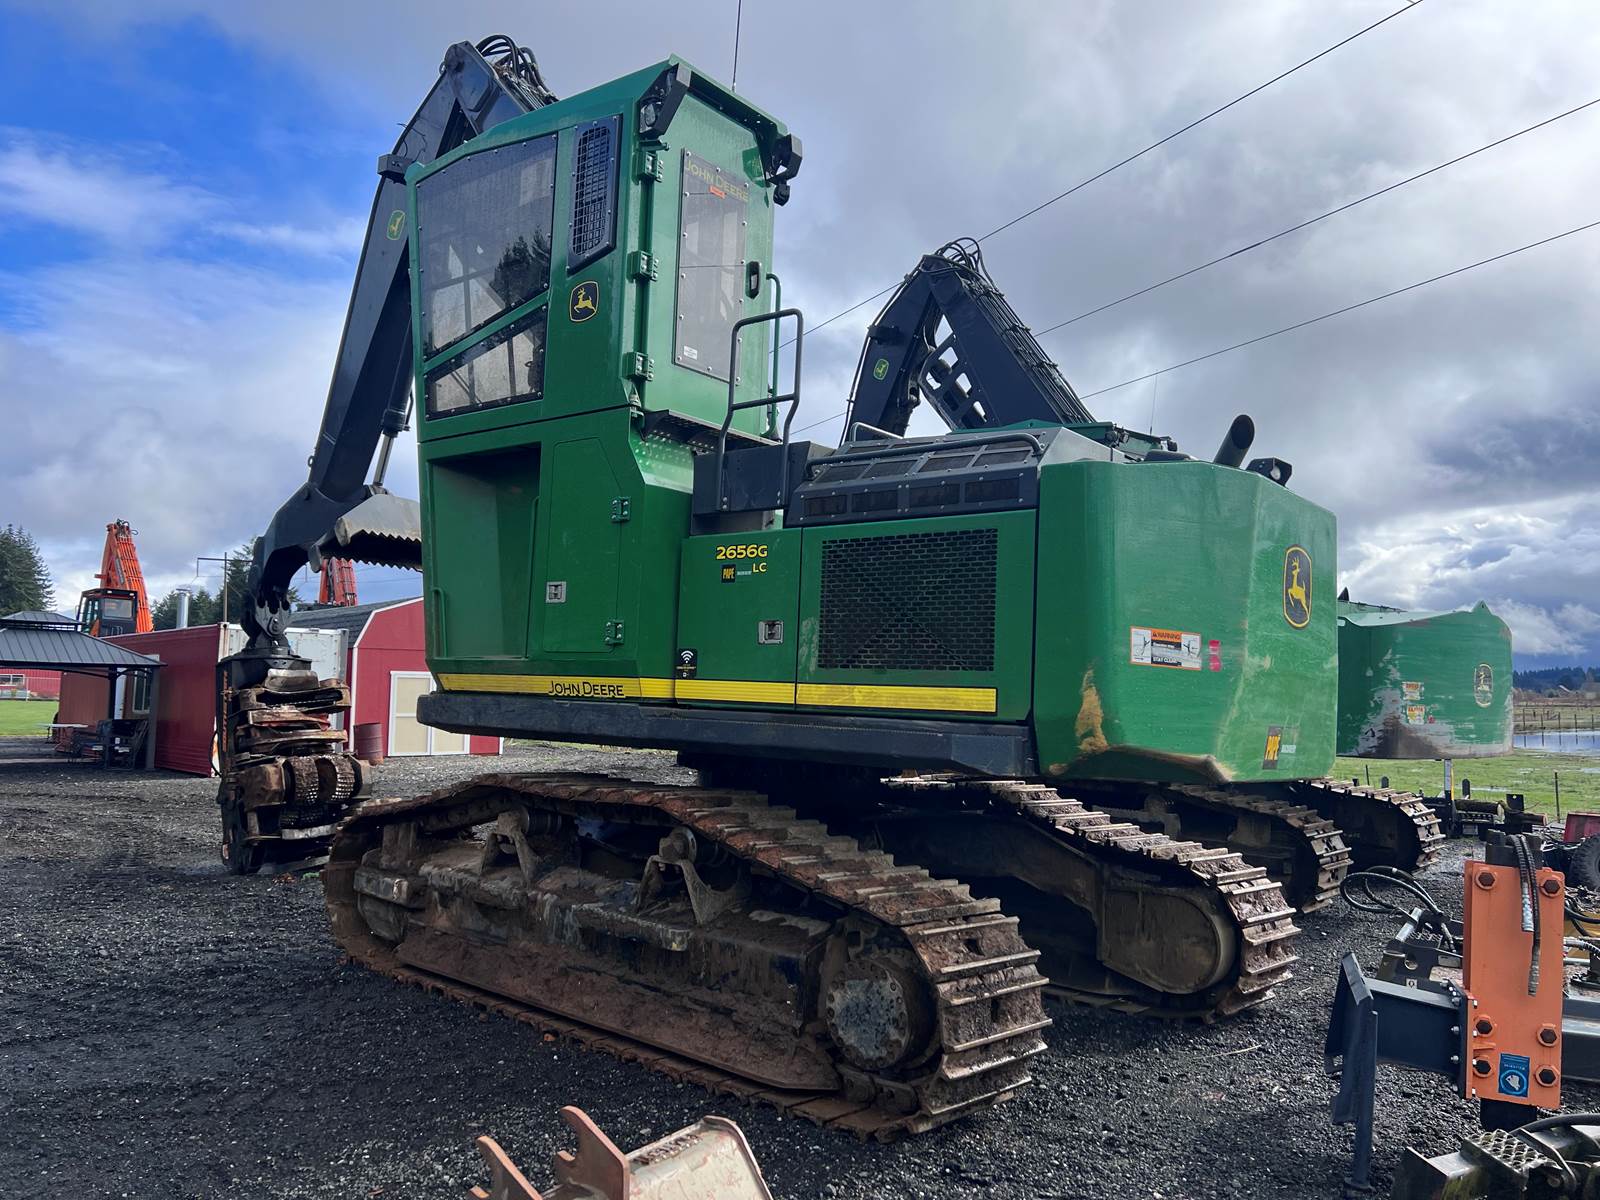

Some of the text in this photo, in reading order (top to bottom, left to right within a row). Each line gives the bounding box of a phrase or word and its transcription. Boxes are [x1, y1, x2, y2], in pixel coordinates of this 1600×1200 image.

[716, 544, 768, 560] 2656G
[752, 562, 767, 573] LC
[548, 681, 625, 697] JOHN DEERE
